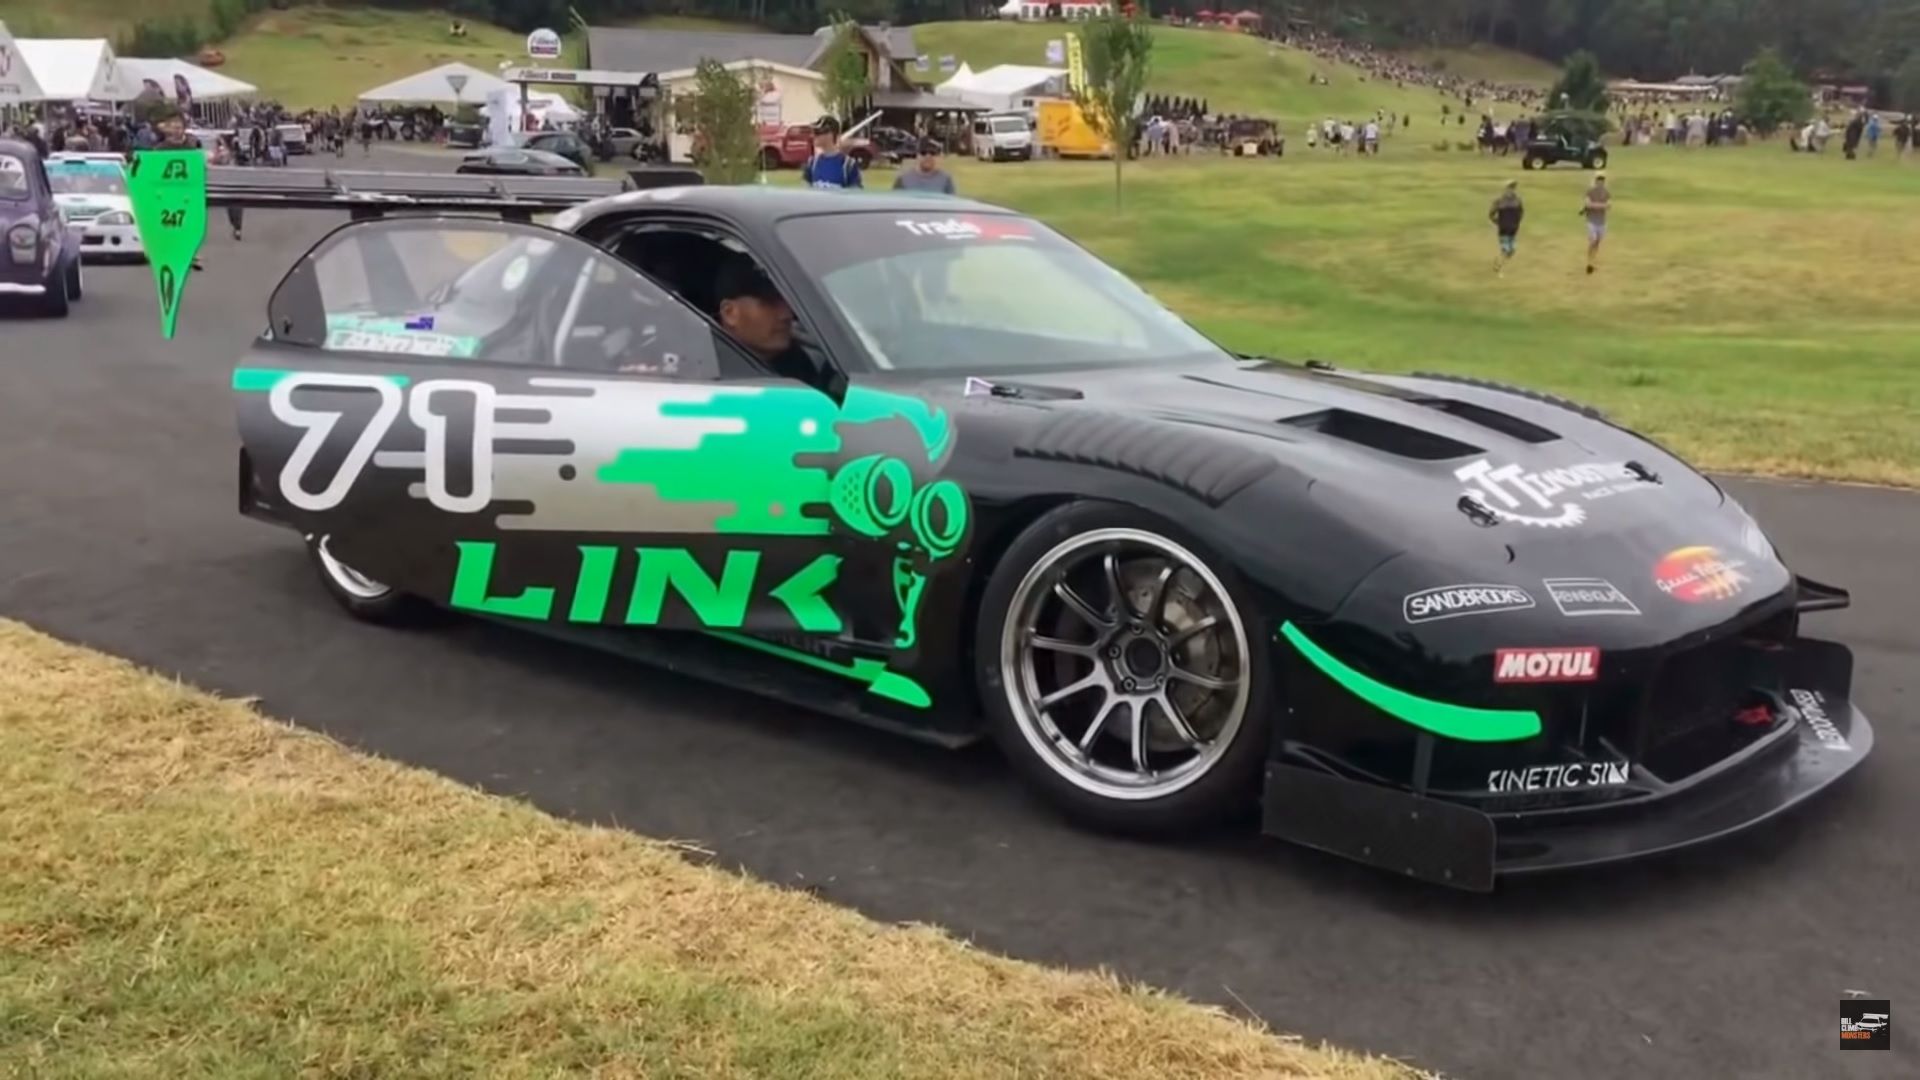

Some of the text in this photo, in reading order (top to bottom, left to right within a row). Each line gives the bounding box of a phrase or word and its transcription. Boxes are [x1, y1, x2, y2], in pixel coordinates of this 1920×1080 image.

[270, 372, 495, 513] 71
[1410, 588, 1528, 616] SANDBROOKS
[1498, 649, 1596, 679] MOTUL
[1488, 763, 1583, 793] KINETIC
